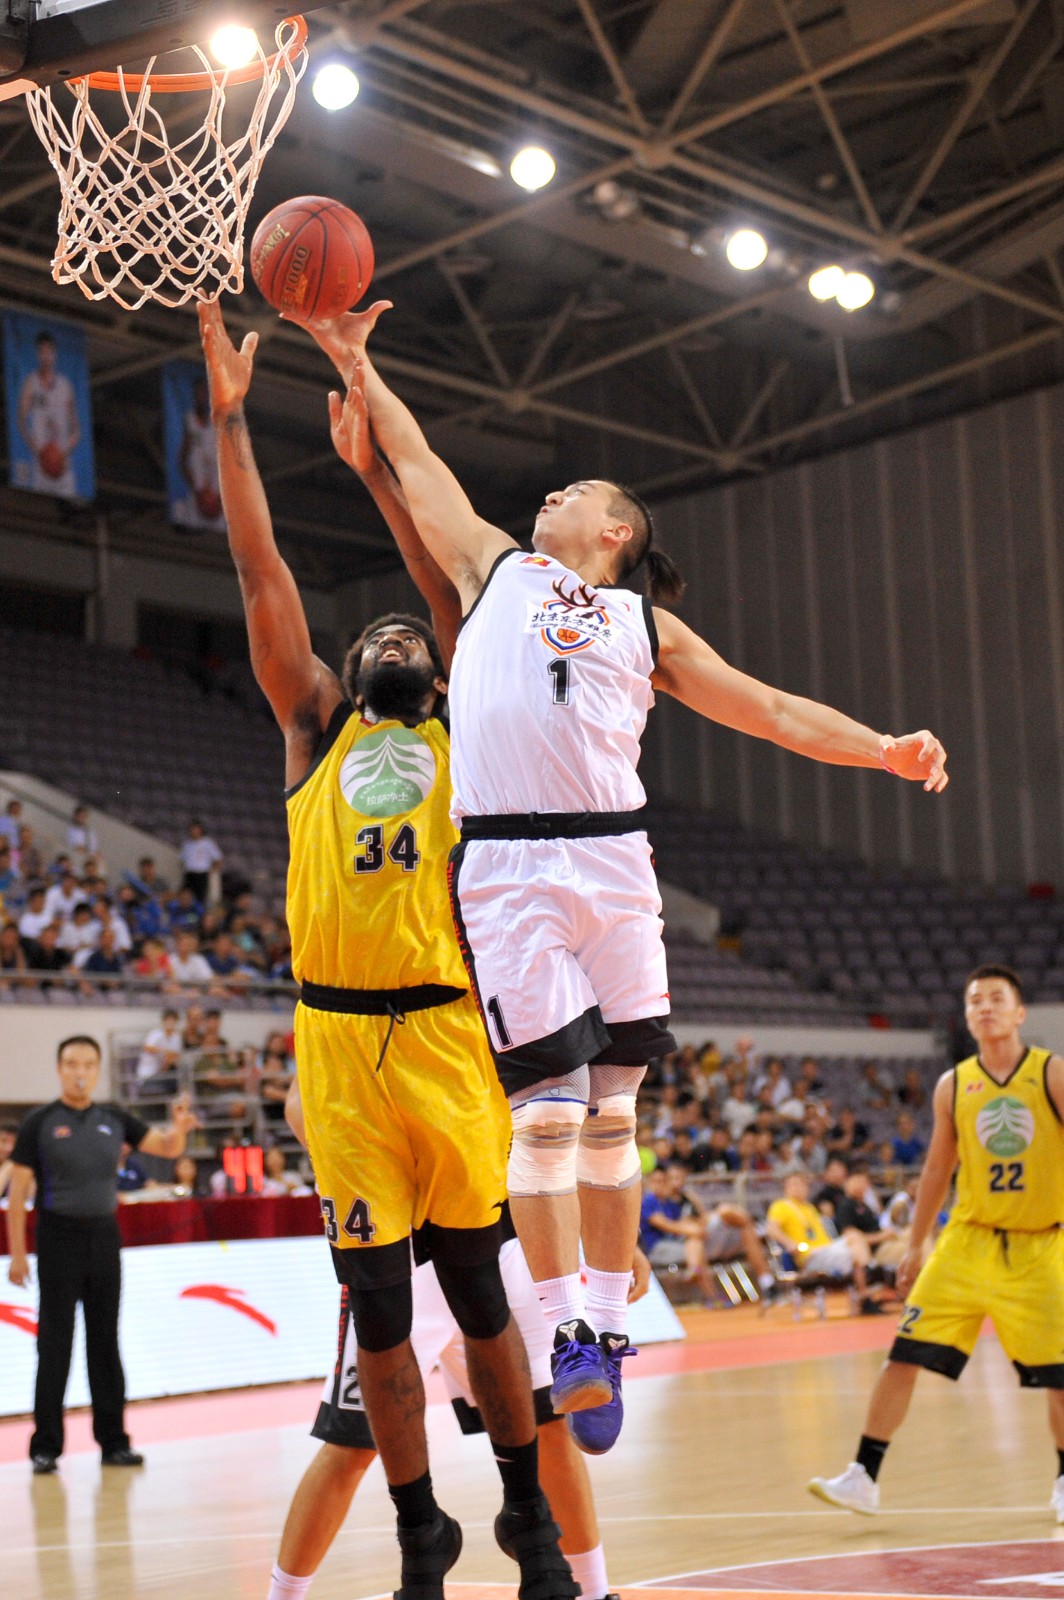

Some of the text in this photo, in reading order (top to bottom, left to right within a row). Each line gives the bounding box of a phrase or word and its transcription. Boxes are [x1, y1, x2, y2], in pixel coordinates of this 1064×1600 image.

[547, 658, 570, 705] 1
[354, 823, 420, 874] 34
[487, 995, 514, 1049] 1
[990, 1162, 1024, 1192] 22
[320, 1197, 376, 1244] 34
